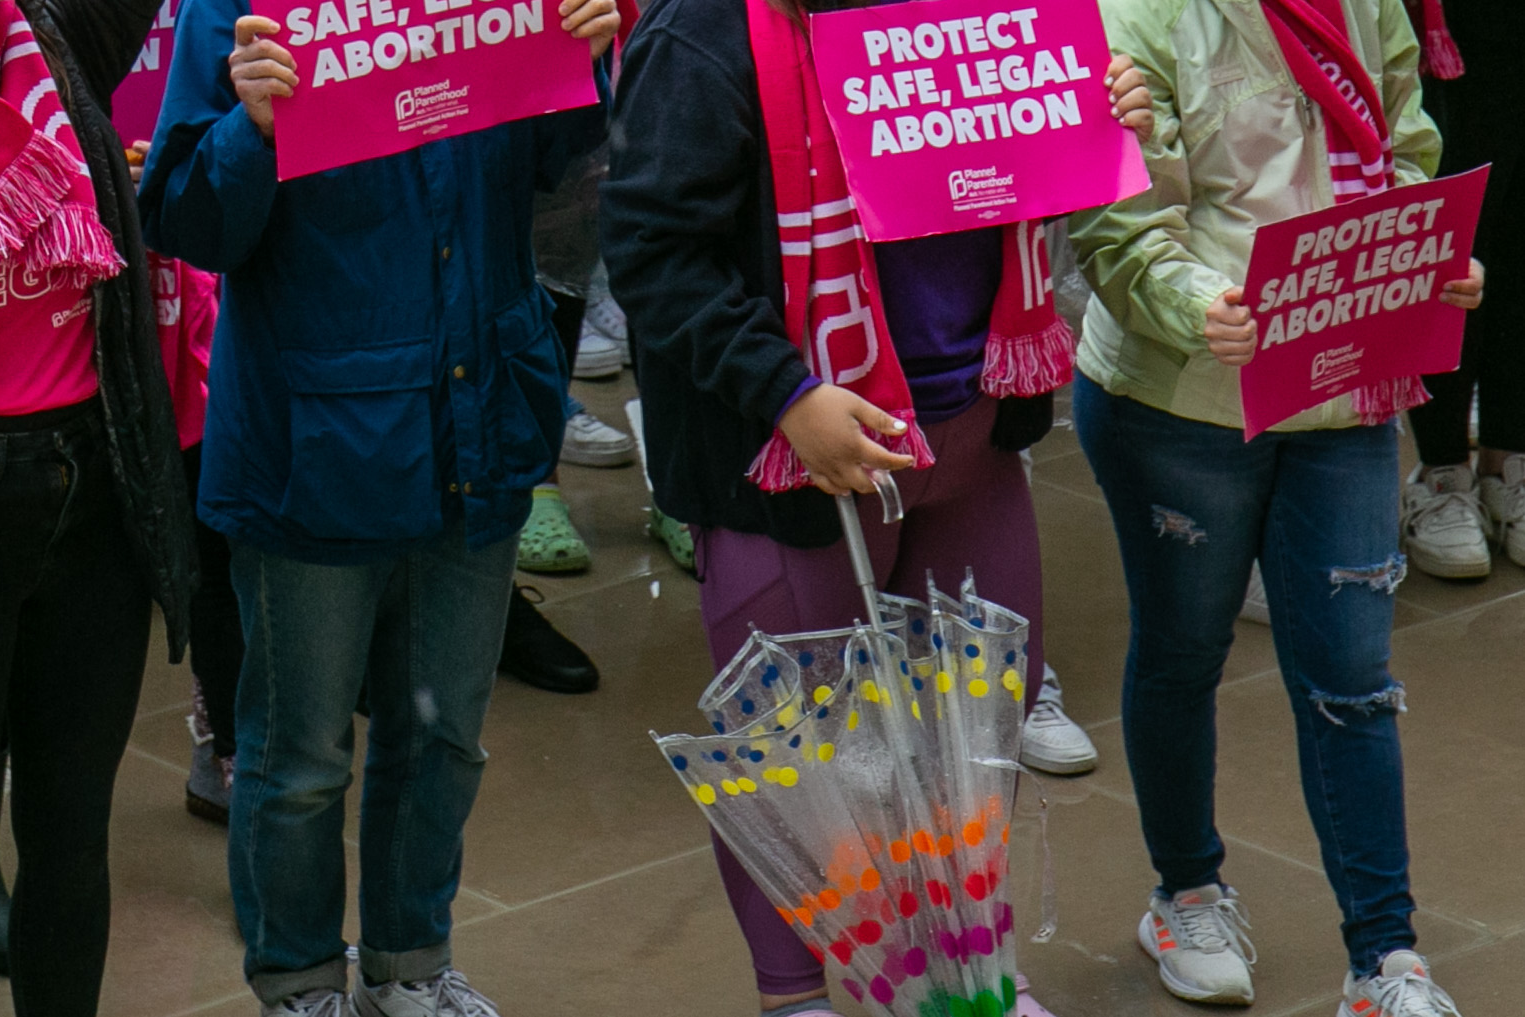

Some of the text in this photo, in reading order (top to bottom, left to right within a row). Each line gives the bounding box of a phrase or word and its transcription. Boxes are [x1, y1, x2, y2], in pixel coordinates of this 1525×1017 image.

[862, 6, 1039, 67] PROTECT
[842, 44, 1092, 116] SAFE, LEGAL
[870, 89, 1083, 157] ABORTION
[1290, 197, 1445, 267] PROTECT
[1256, 230, 1456, 314] SAFE, LEGAL
[1260, 270, 1437, 351] ABORTION
